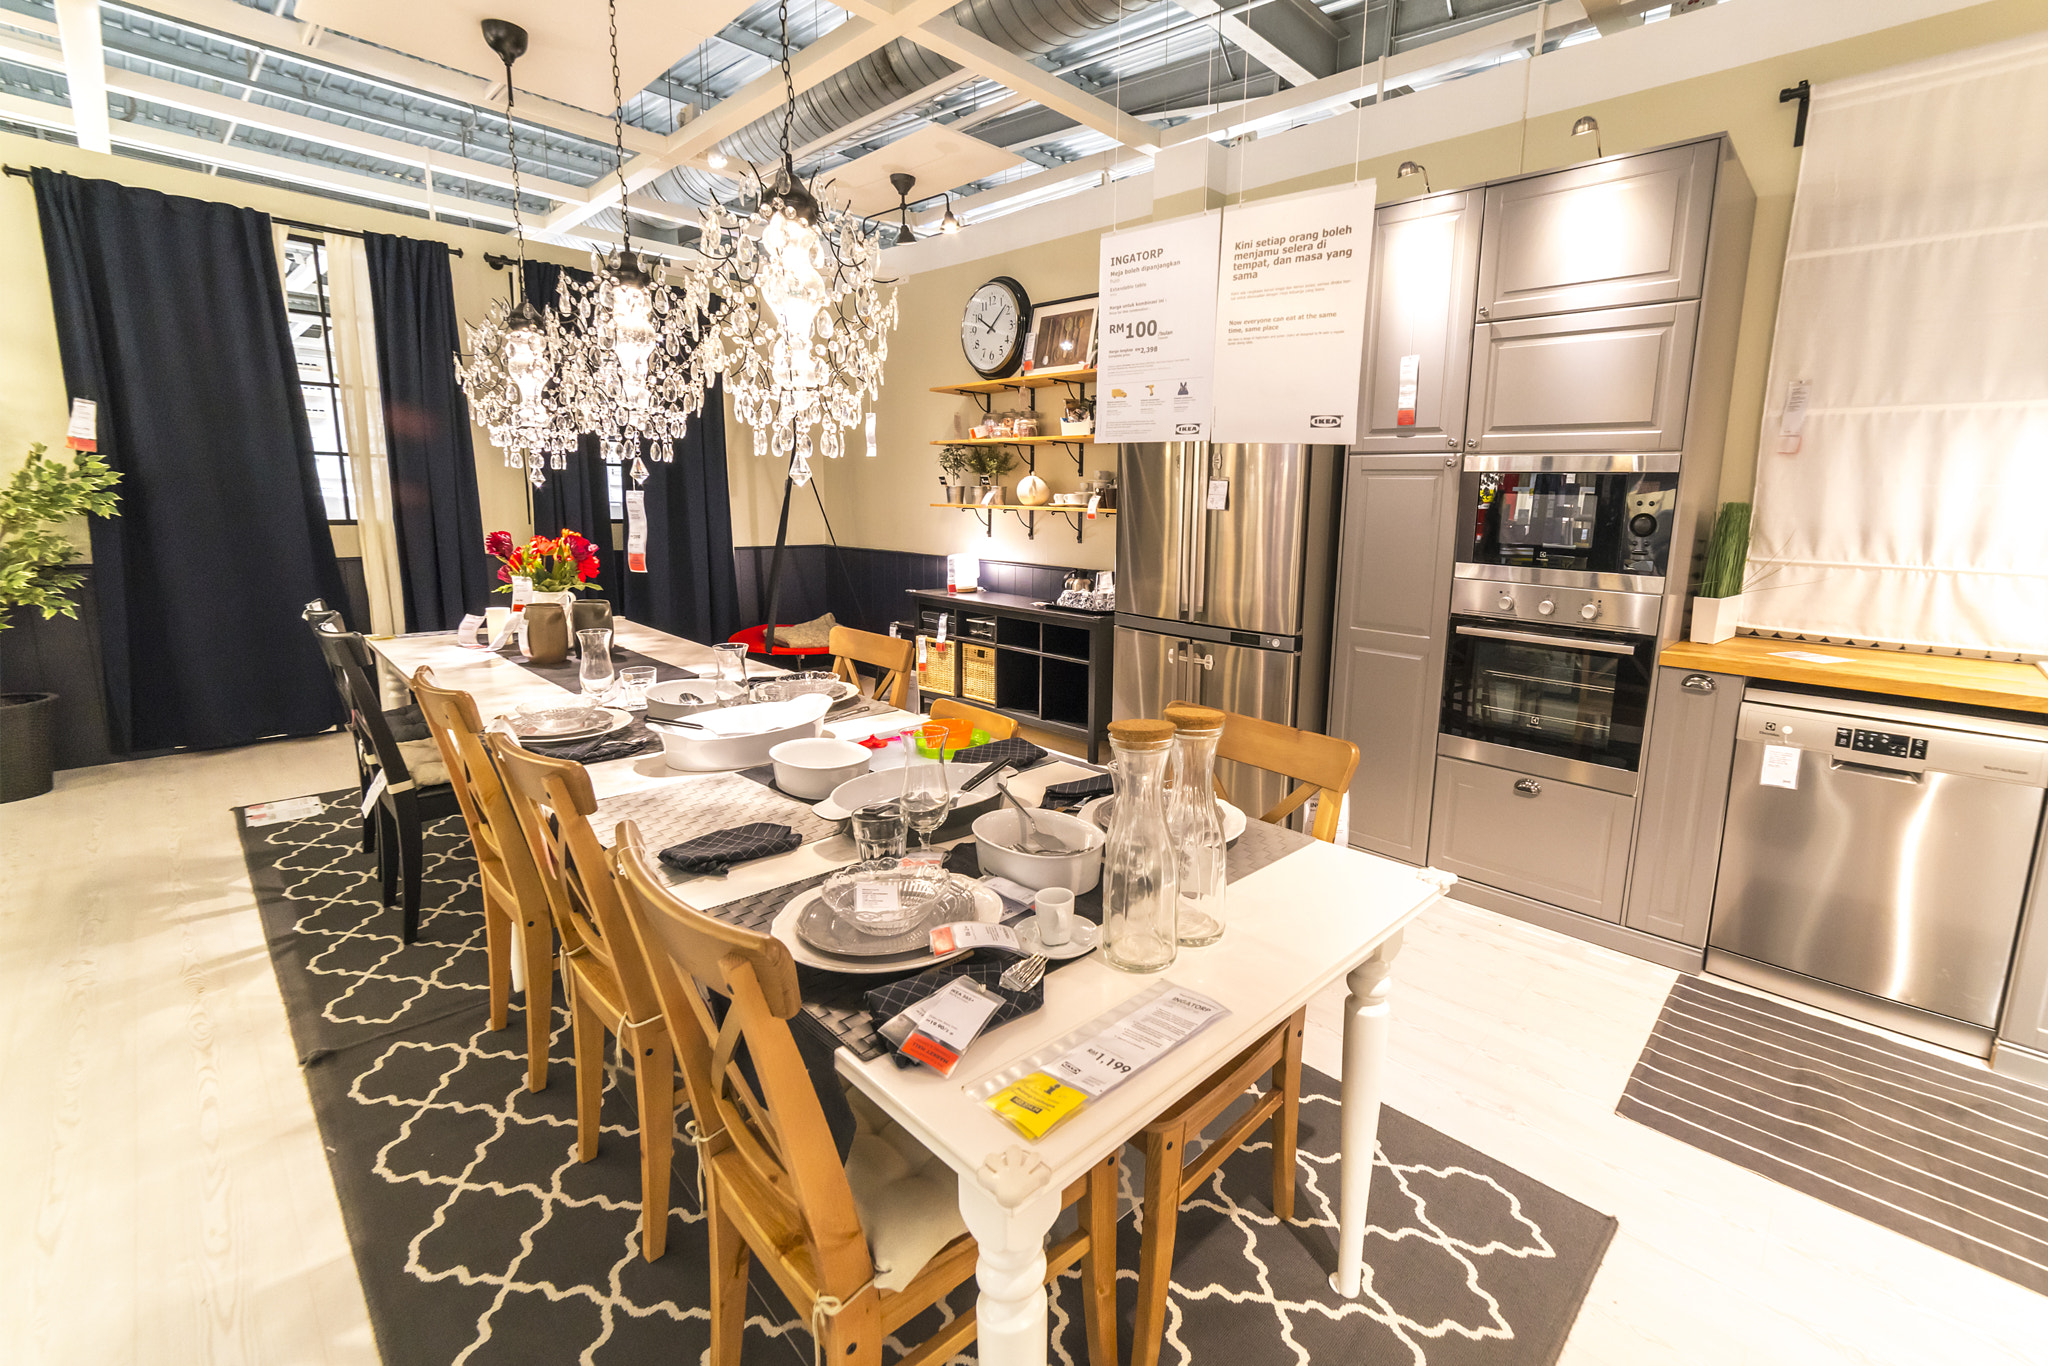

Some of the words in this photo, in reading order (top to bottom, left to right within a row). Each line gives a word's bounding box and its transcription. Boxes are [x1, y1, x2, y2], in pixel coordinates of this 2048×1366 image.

[1234, 240, 1253, 250] Kini
[1256, 236, 1286, 248] setiap
[1289, 232, 1319, 242] orang
[1322, 225, 1352, 238] boleh
[1234, 248, 1279, 260] menjamu
[1282, 243, 1313, 254] selera
[1317, 240, 1327, 249] di
[1110, 248, 1164, 266] INGATORP
[1233, 259, 1270, 271] tempat,
[1273, 256, 1292, 266] dan
[1295, 252, 1323, 263] masa
[1326, 248, 1352, 260] yang
[1124, 266, 1140, 274] boleh
[1141, 260, 1181, 272] dipanjangkan
[1233, 272, 1258, 281] sama
[981, 302, 988, 312] 11
[988, 296, 996, 306] 12
[975, 314, 982, 323] 10
[1244, 317, 1271, 326] everyone
[1314, 417, 1338, 426] IKEA
[1172, 996, 1211, 1012] INGATORP
